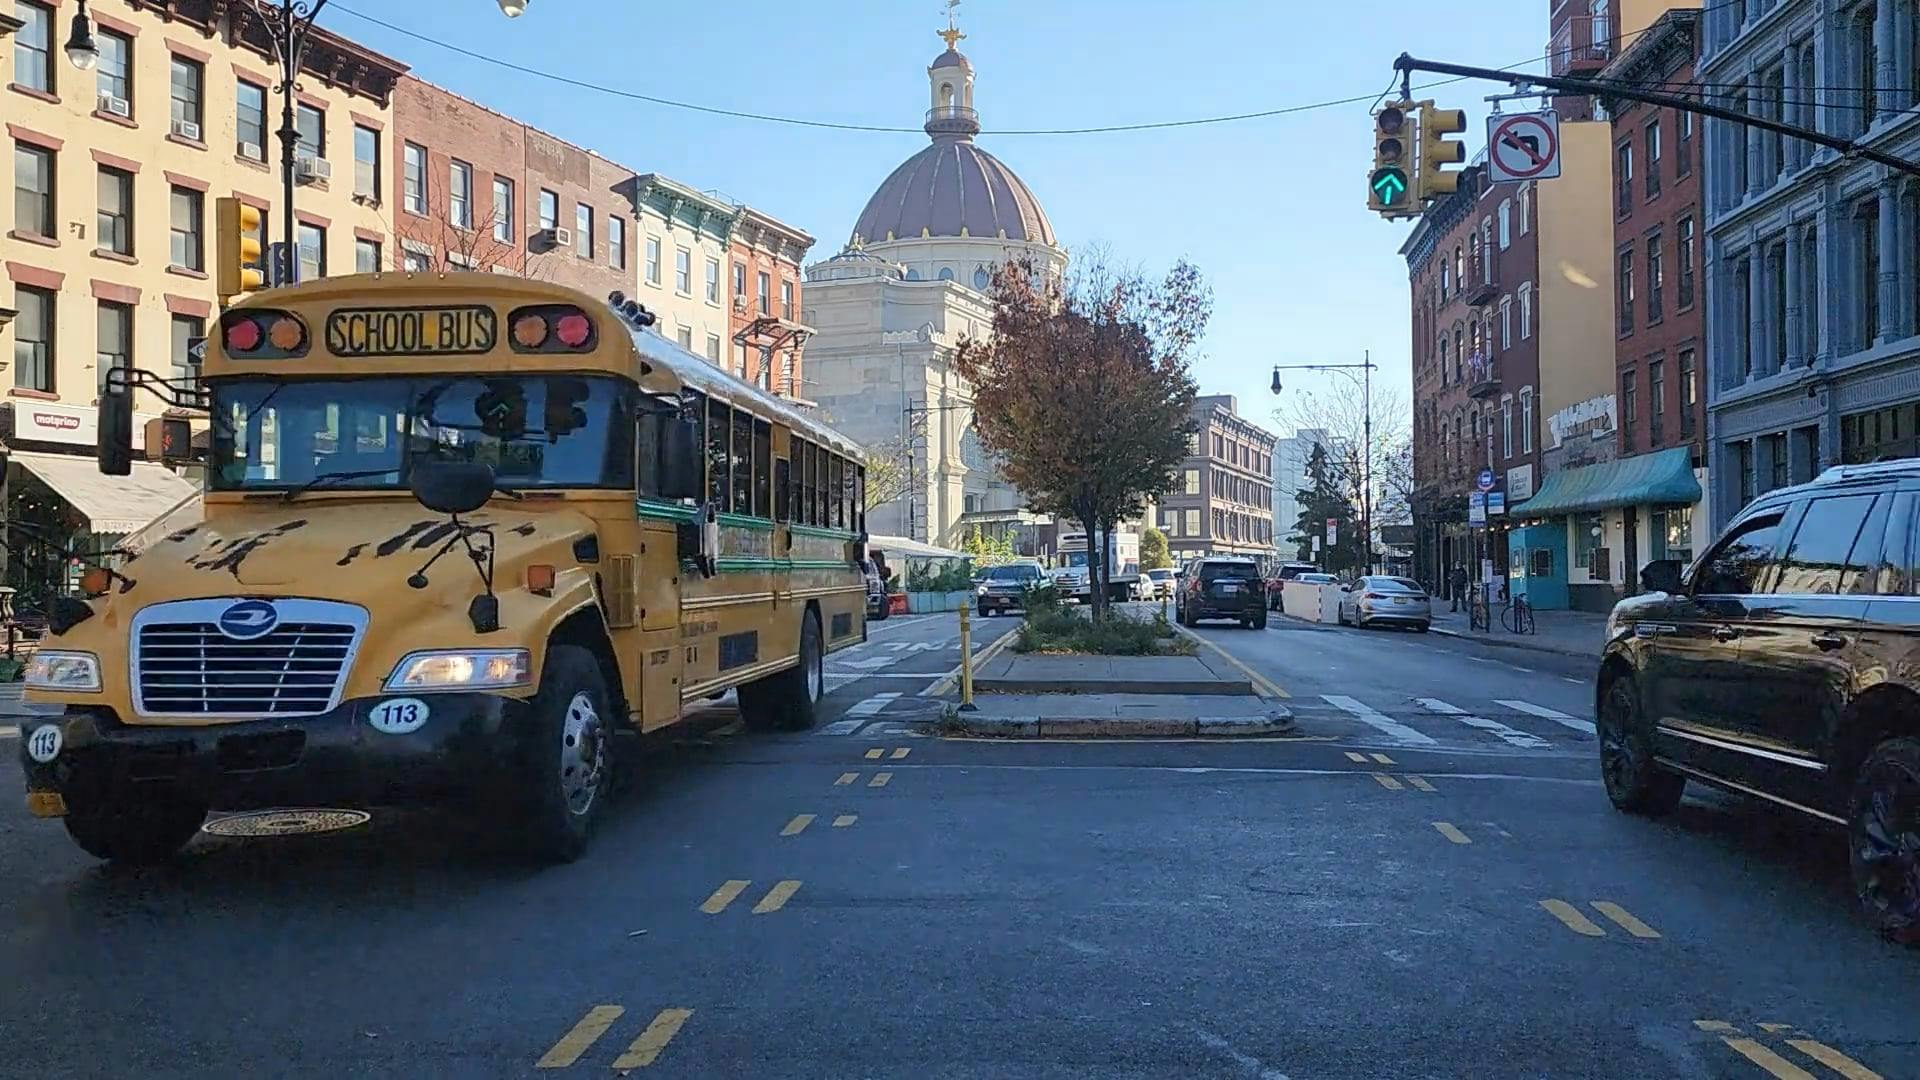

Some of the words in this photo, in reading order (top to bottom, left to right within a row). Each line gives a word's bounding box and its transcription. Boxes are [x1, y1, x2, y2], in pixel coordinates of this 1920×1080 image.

[332, 312, 433, 352] SCHOOL
[438, 310, 490, 349] BUS
[381, 704, 418, 725] 113
[34, 732, 56, 756] 113
